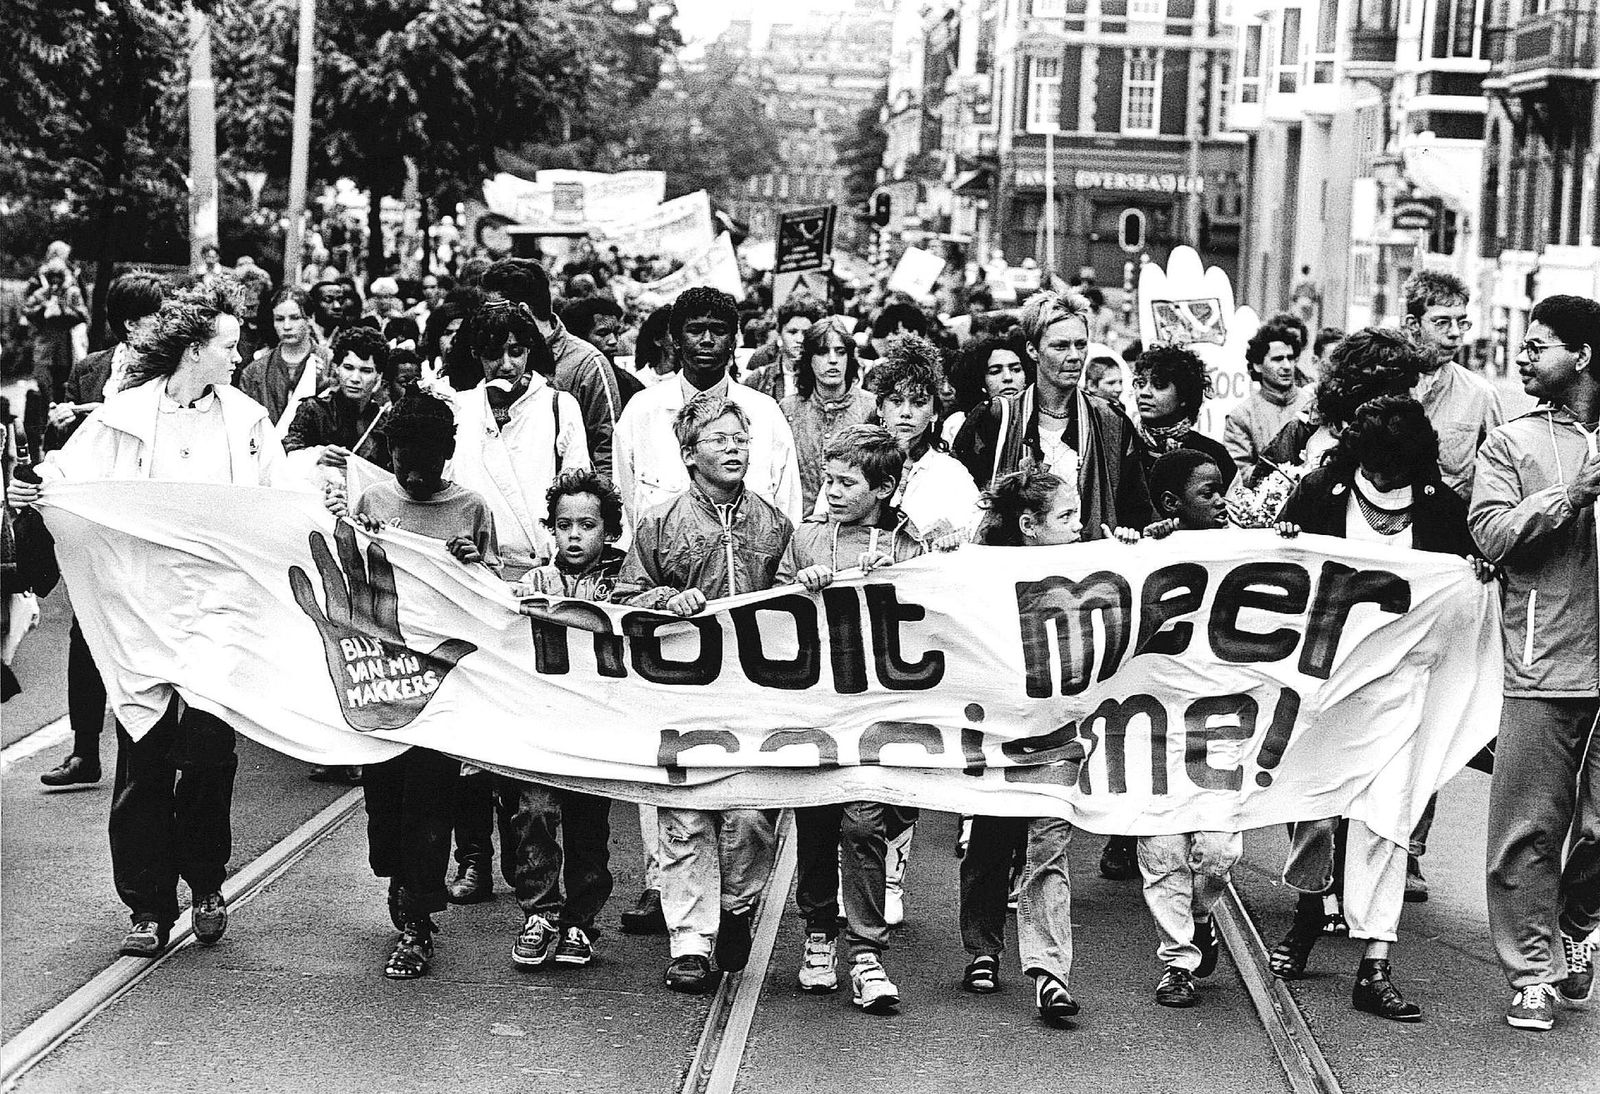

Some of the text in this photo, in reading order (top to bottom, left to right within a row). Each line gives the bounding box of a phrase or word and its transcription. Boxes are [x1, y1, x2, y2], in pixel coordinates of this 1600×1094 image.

[1015, 560, 1411, 698] meer
[346, 658, 386, 684] VAN
[346, 670, 440, 708] MAKKERS
